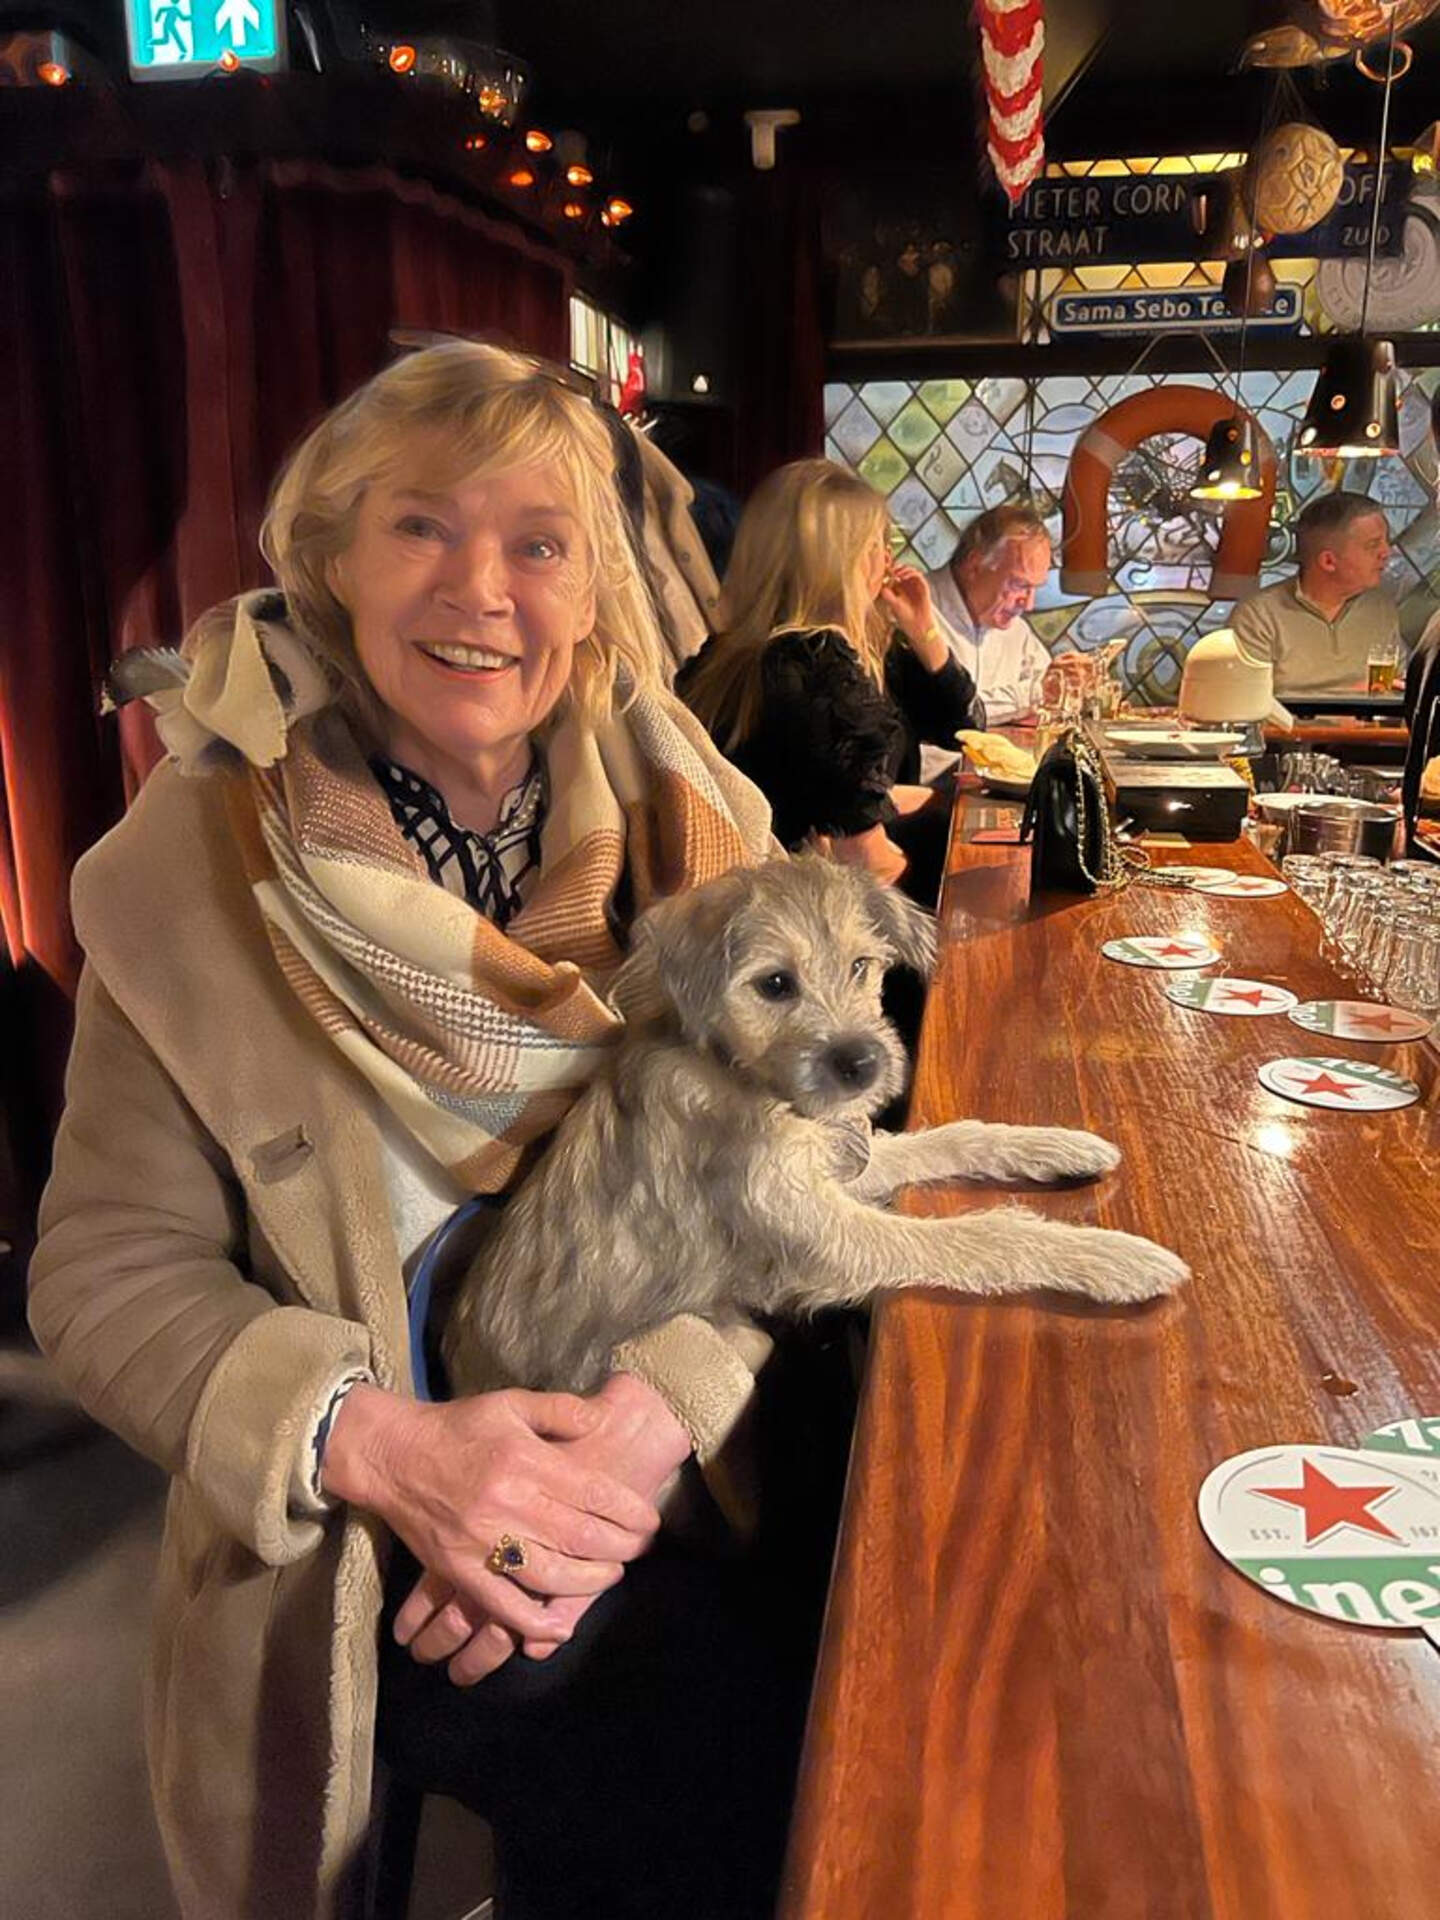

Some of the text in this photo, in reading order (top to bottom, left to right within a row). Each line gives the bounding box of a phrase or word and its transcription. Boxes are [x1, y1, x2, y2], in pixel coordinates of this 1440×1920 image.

[1008, 227, 1109, 259] STRAAT
[1064, 303, 1126, 322] Sama
[1133, 299, 1191, 319] Sebo
[1259, 1566, 1440, 1624] ine
